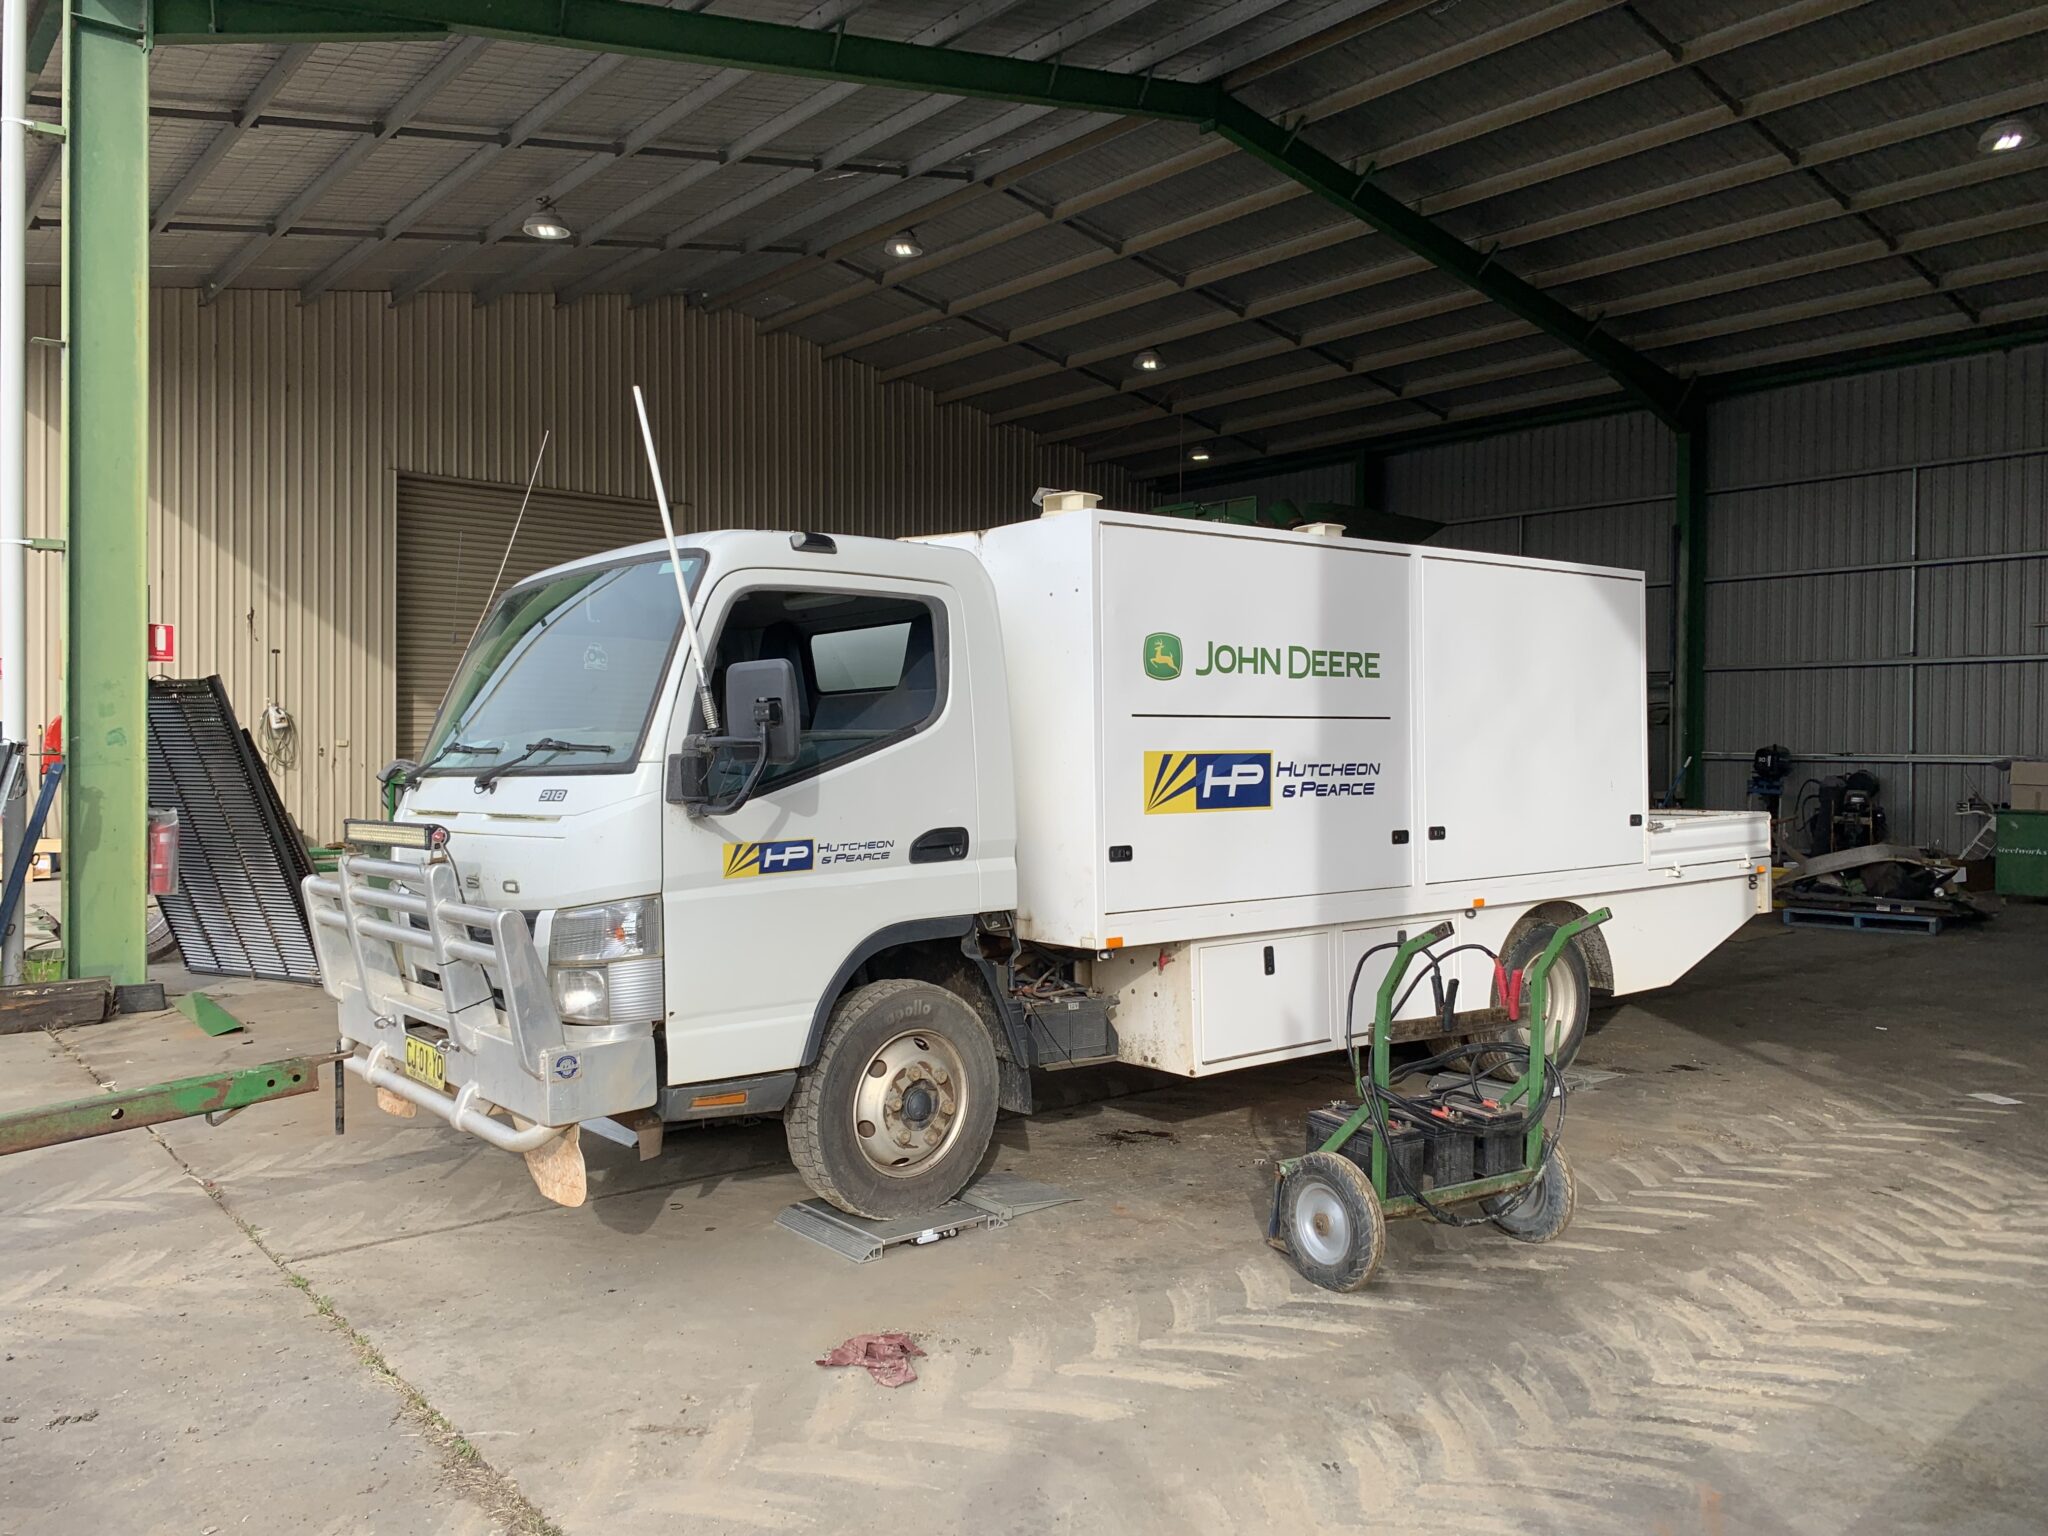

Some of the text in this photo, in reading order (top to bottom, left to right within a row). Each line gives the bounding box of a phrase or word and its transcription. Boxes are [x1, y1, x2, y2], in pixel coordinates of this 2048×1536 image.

[1196, 641, 1381, 679] JOHN DEERE
[1276, 761, 1381, 778] HUTCHEON
[1202, 764, 1264, 799] HP
[1282, 781, 1375, 798] & PEARCE
[539, 789, 568, 802] 918
[817, 840, 895, 853] HUTCHEON
[763, 845, 809, 868] HP
[821, 851, 890, 864] & PEARCE
